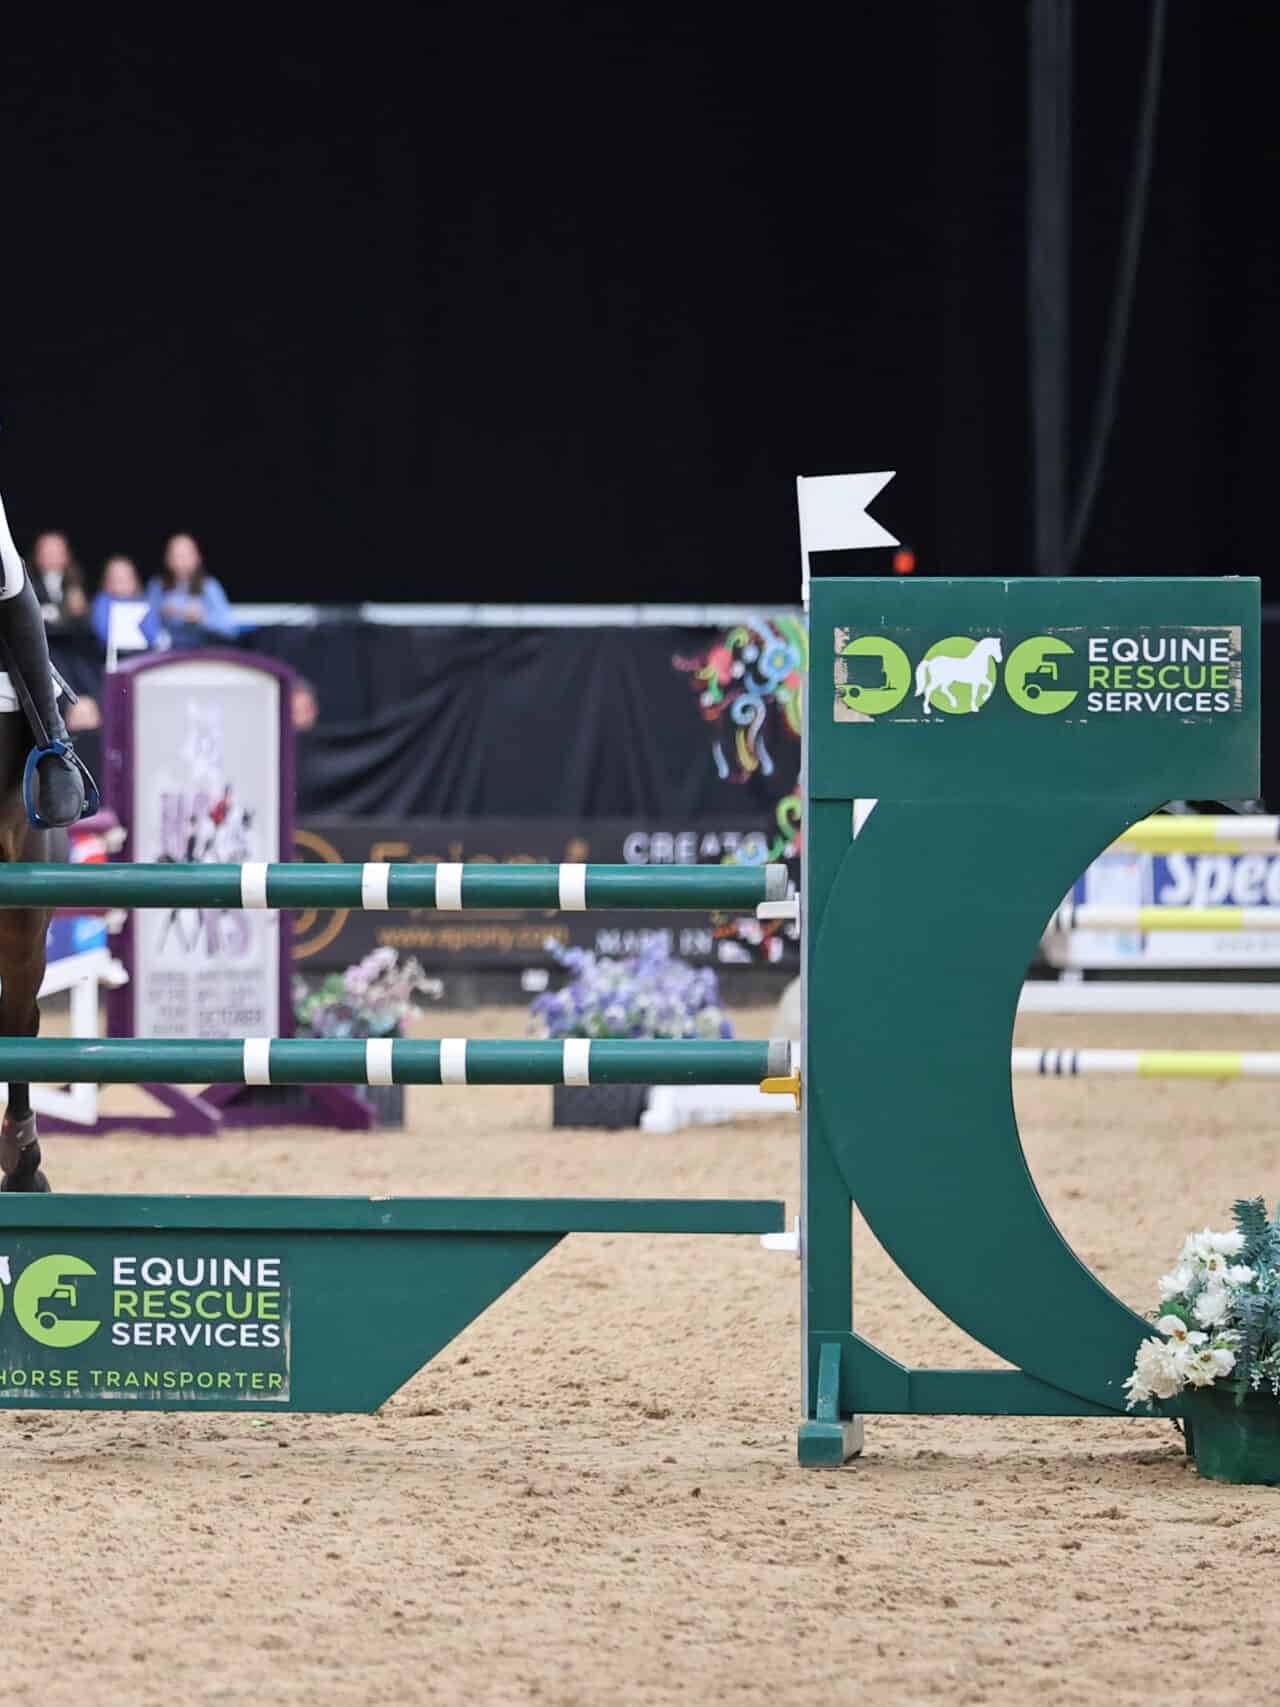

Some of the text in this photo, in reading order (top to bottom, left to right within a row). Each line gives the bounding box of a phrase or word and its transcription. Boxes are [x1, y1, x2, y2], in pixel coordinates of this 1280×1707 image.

[1087, 638, 1231, 663] EQUINE
[1088, 665, 1231, 689] RESCUE
[1087, 691, 1231, 712] SERVICES
[112, 1256, 281, 1288] EQUINE
[113, 1290, 281, 1320] RESCUE
[111, 1322, 281, 1348] SERVICES
[89, 1370, 283, 1389] TRANSPORTER
